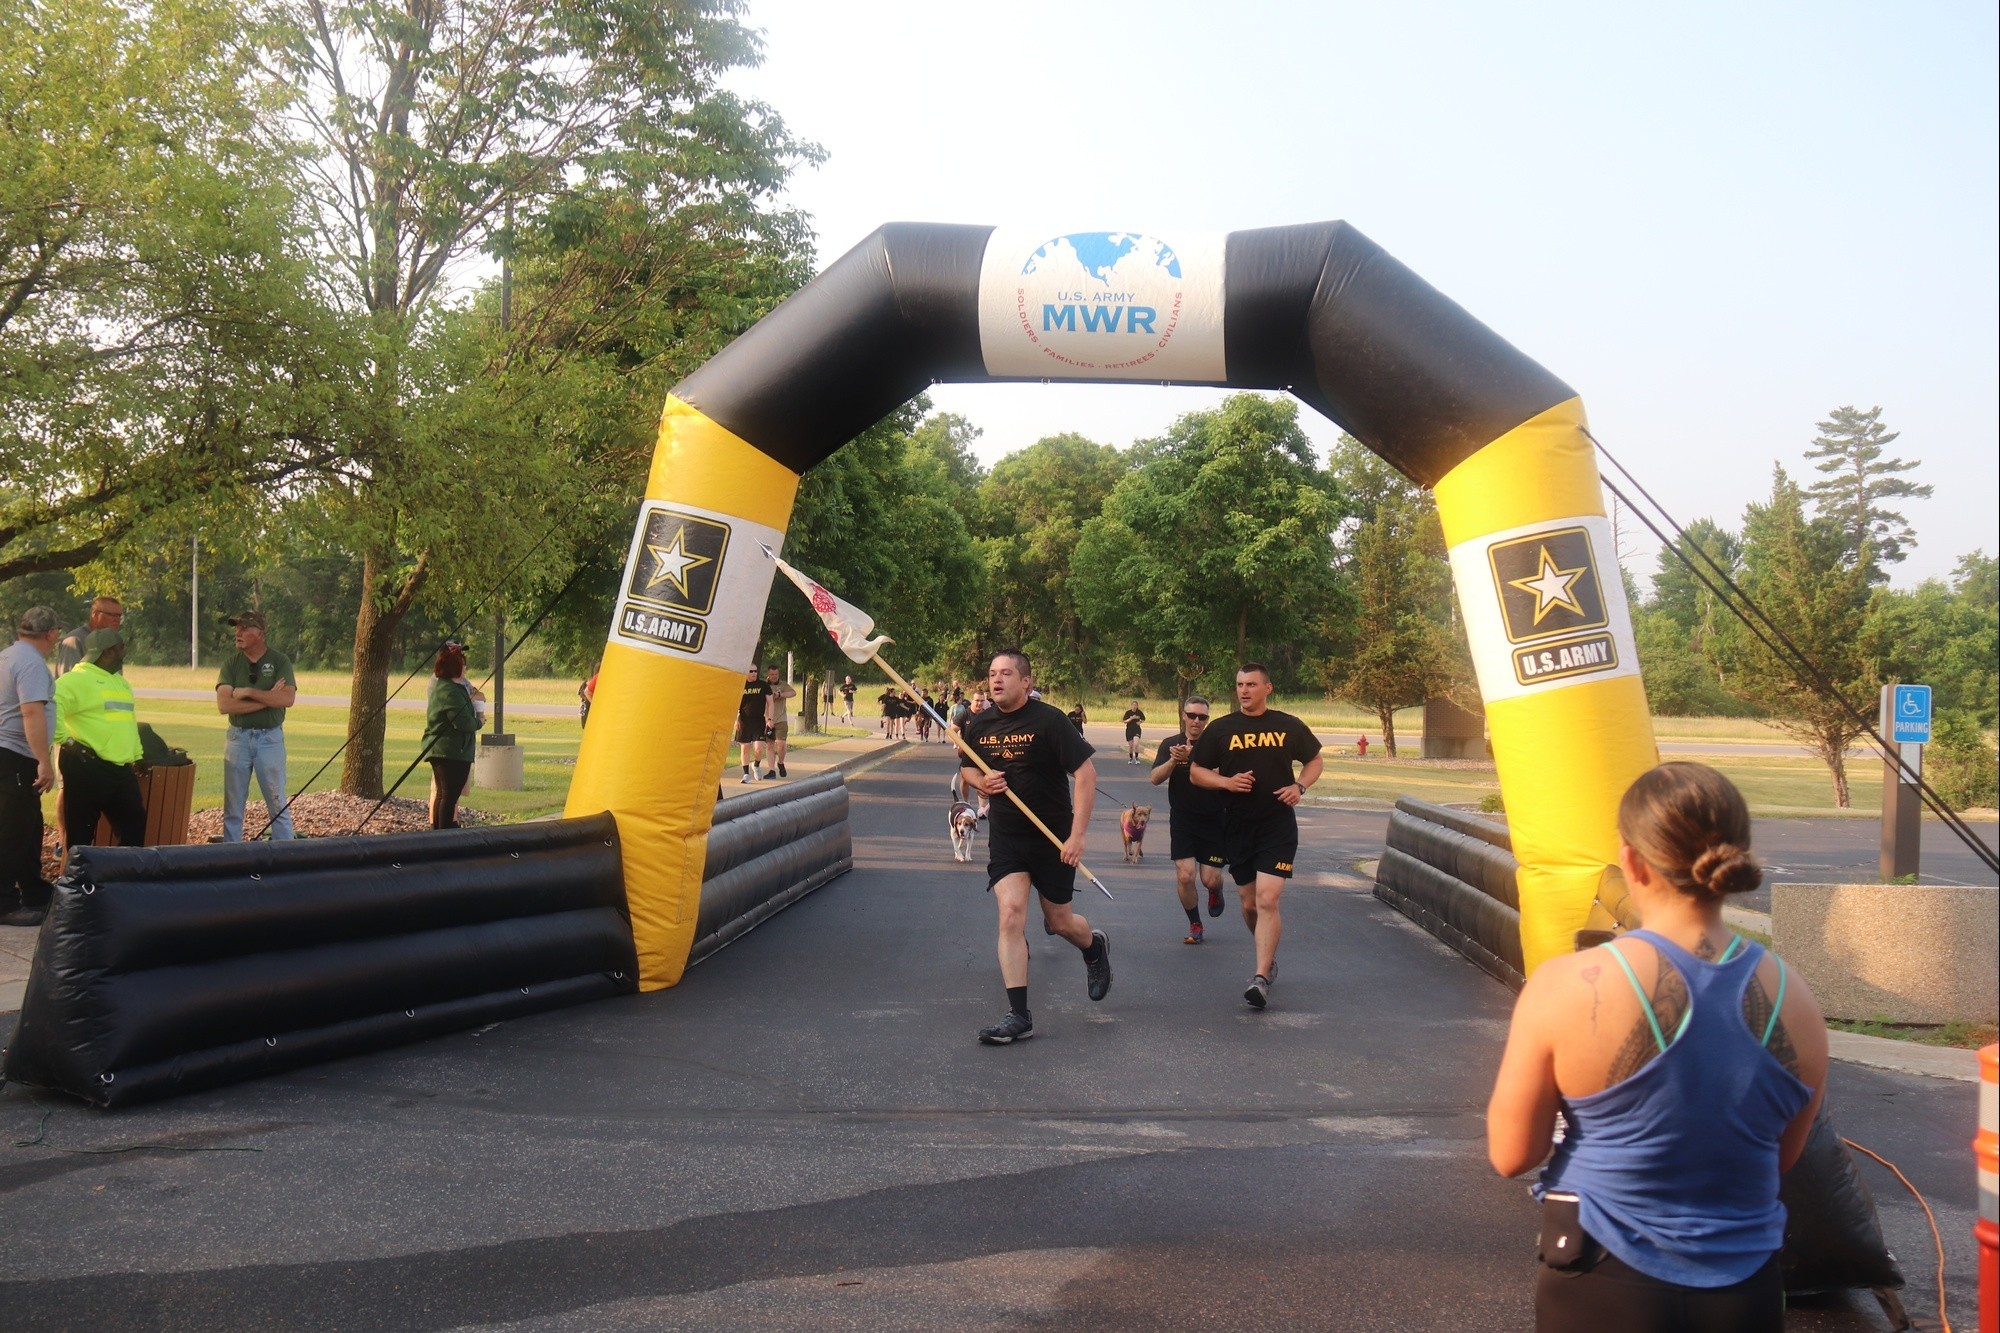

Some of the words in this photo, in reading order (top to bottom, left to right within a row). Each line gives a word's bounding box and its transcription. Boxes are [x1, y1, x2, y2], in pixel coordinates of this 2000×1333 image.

[1058, 291, 1087, 302] U.S.
[1092, 292, 1135, 303] ARMY
[1042, 303, 1157, 334] MWR
[1017, 287, 1039, 343] SOLDIERS
[1043, 347, 1095, 369] FAMILIES
[1104, 351, 1155, 369] RETIREES
[1158, 292, 1182, 348] CIVILIANS
[1895, 721, 1929, 734] PARKING
[979, 735, 1001, 745] U.S.
[1003, 733, 1035, 744] ARMY
[1228, 731, 1287, 751] ARMY
